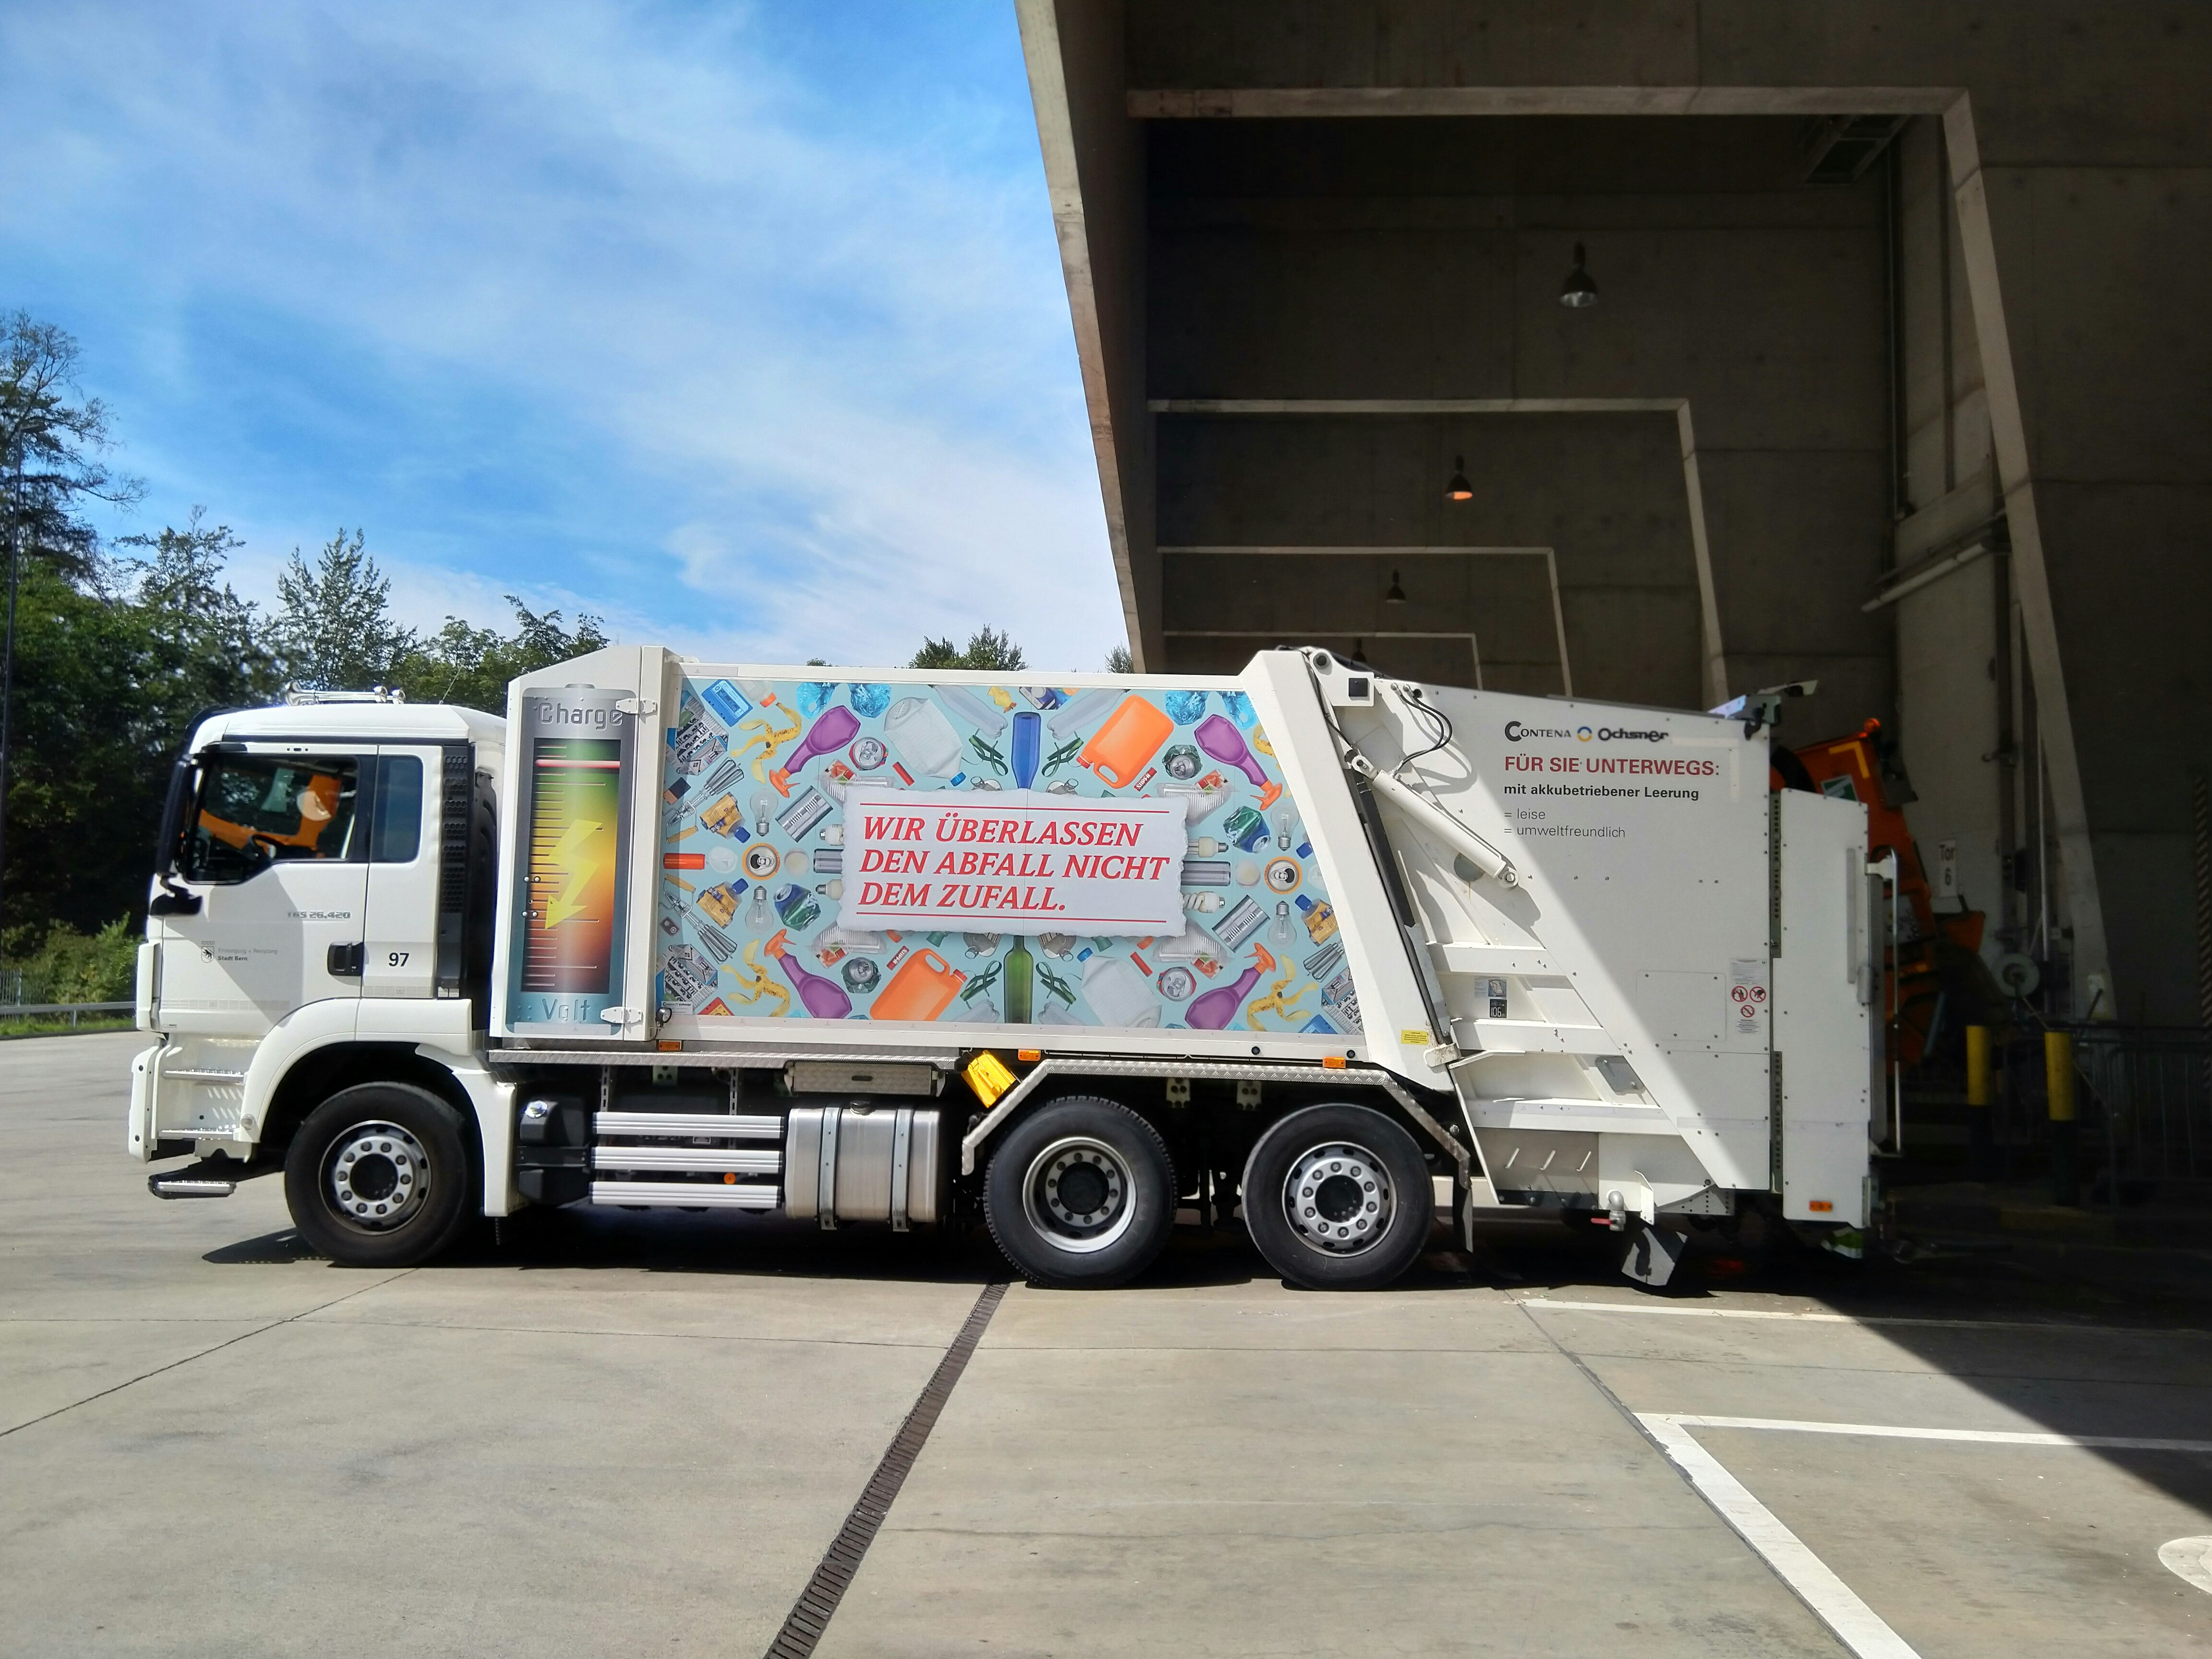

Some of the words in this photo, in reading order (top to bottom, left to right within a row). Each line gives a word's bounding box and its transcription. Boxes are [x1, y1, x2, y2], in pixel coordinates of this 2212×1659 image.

[539, 703, 623, 730] Charge
[1504, 721, 1571, 742] CONTENA
[1598, 727, 1669, 742] Ochsner
[1505, 754, 1543, 771] FÜR
[1550, 758, 1578, 772] SIE
[1587, 758, 1719, 776] UNTERWEGS:
[1504, 784, 1526, 794] mit
[1531, 784, 1640, 797] akkubetriebener
[1645, 786, 1699, 801] Leerung
[1517, 808, 1546, 820] leise
[865, 816, 926, 841] WIR
[936, 812, 1142, 846] ÜBERLASSEN
[1517, 825, 1625, 838] umweltfreundlich
[1939, 844, 1956, 861] Tor
[860, 849, 930, 874] DEN
[934, 852, 1054, 877] ABFALL
[1062, 854, 1170, 880] NICHT
[1945, 867, 1951, 885] 6
[859, 882, 931, 906] DEM
[937, 884, 1065, 911] ZUFALL.
[389, 952, 409, 967] 97
[542, 998, 591, 1021] Volt
[1491, 1007, 1502, 1017] 106
